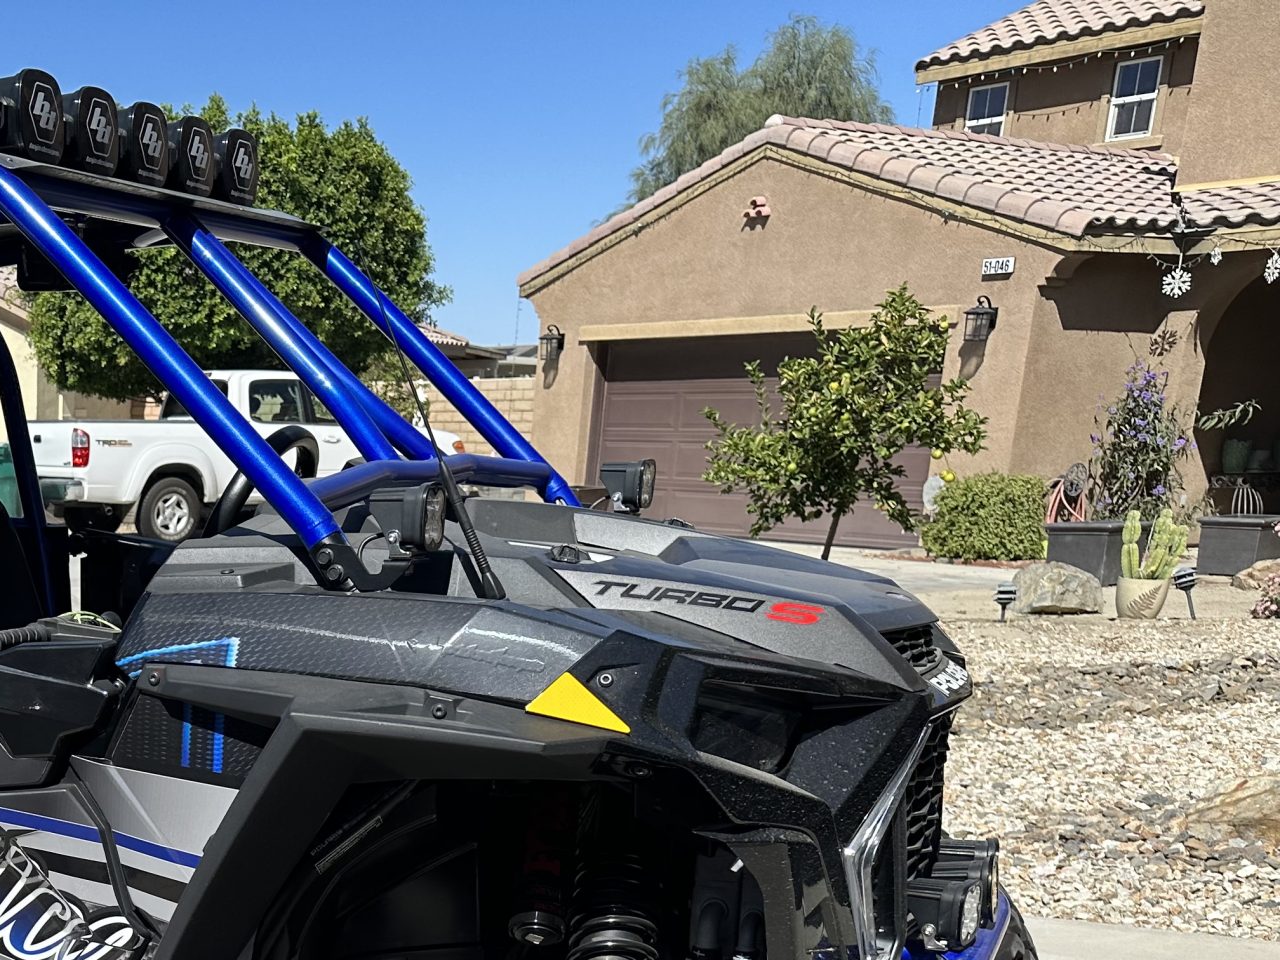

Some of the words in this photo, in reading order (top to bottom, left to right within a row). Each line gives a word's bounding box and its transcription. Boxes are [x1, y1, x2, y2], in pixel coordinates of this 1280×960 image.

[983, 259, 1010, 273] 51-046
[592, 580, 766, 613] TURBO
[765, 601, 825, 625] S
